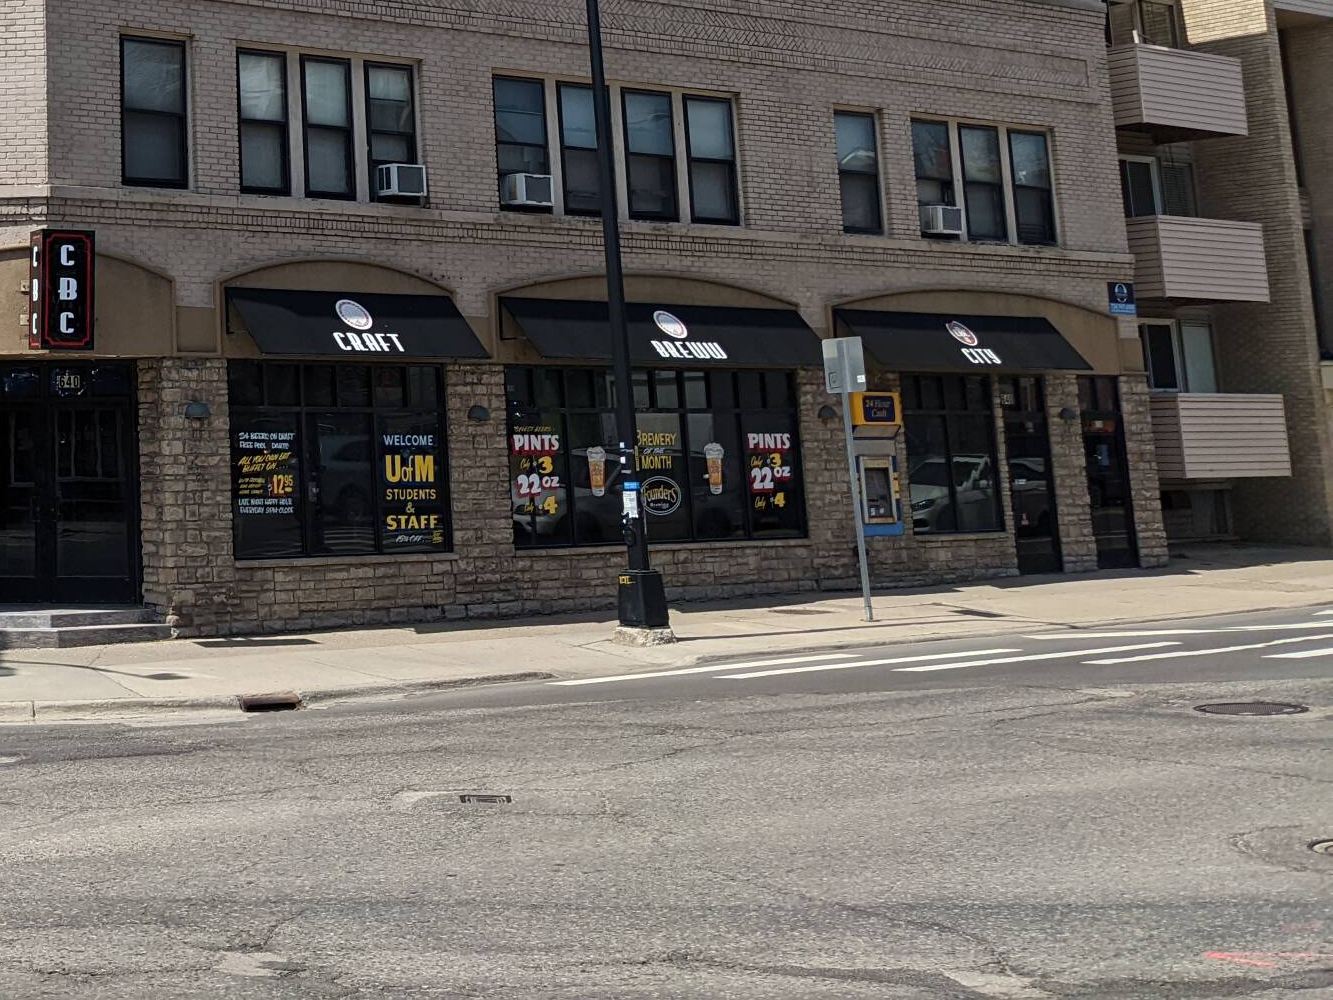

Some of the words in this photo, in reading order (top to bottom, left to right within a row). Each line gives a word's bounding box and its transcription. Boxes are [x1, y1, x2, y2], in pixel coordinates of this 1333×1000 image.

[332, 331, 405, 352] CRAFT
[960, 347, 1002, 364] CITY
[59, 376, 79, 388] 640
[239, 441, 254, 449] FREE
[383, 434, 434, 446] WELCOME
[512, 434, 560, 451] PINTS
[747, 432, 791, 449] PINTS
[237, 456, 252, 466] ALL
[641, 455, 672, 470] MONTH
[517, 473, 542, 494] 22
[542, 475, 560, 488] OZ
[751, 466, 774, 489] 22
[773, 466, 791, 477] OZ
[386, 488, 436, 500] STUDENTS
[642, 484, 677, 503] Founders
[405, 501, 415, 513] &
[386, 515, 439, 530] STAFF
